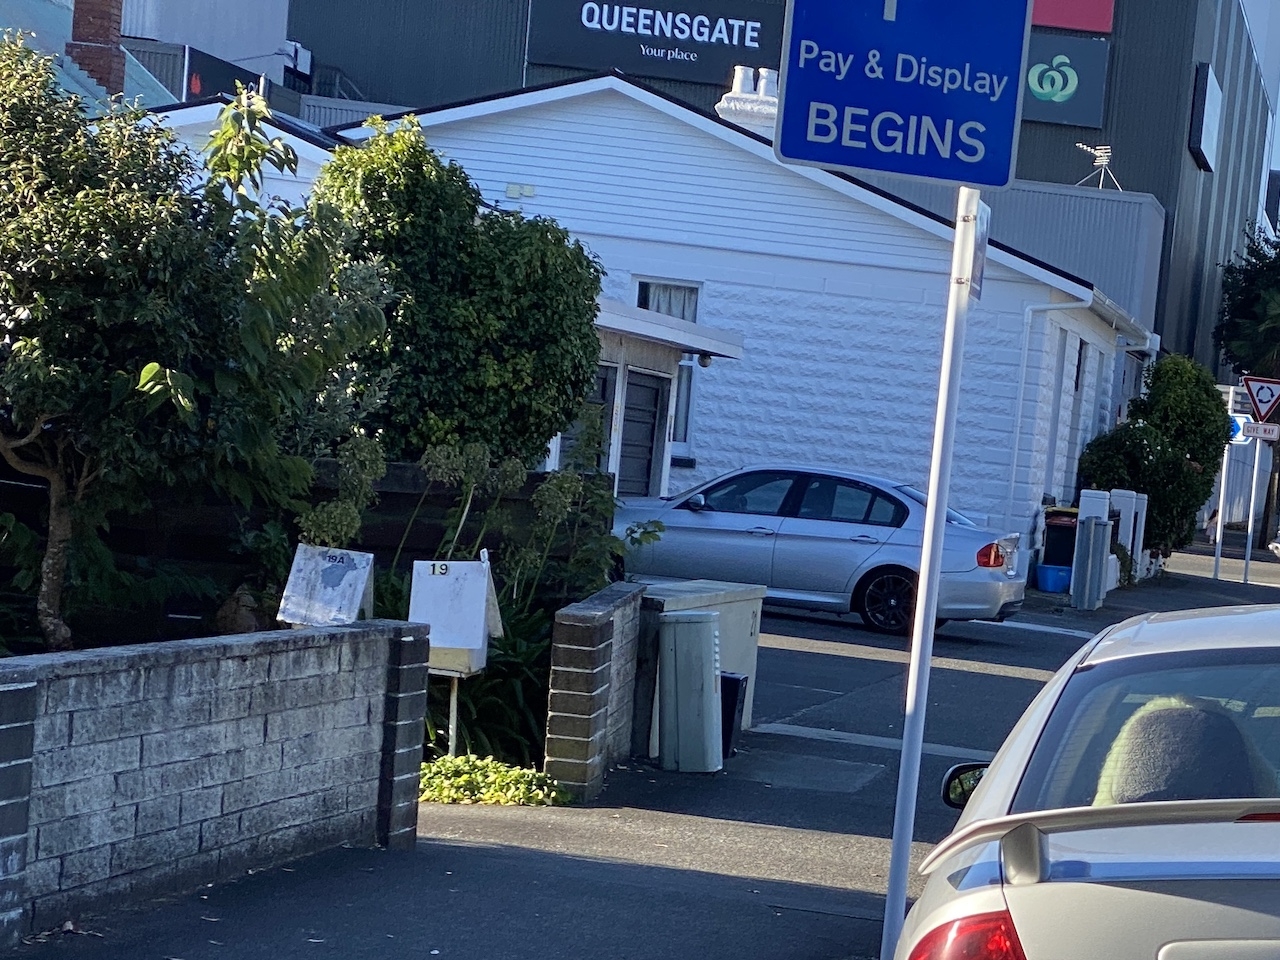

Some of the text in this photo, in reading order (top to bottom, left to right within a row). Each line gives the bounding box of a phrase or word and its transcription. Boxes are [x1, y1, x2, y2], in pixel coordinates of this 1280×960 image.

[581, 2, 761, 47] QUEENSGATE
[640, 44, 698, 62] Your place
[799, 39, 1008, 101] Pay & Display
[807, 101, 987, 163] BEGINS
[1246, 427, 1259, 435] GIVE
[326, 554, 345, 564] 19A
[430, 563, 448, 575] 19
